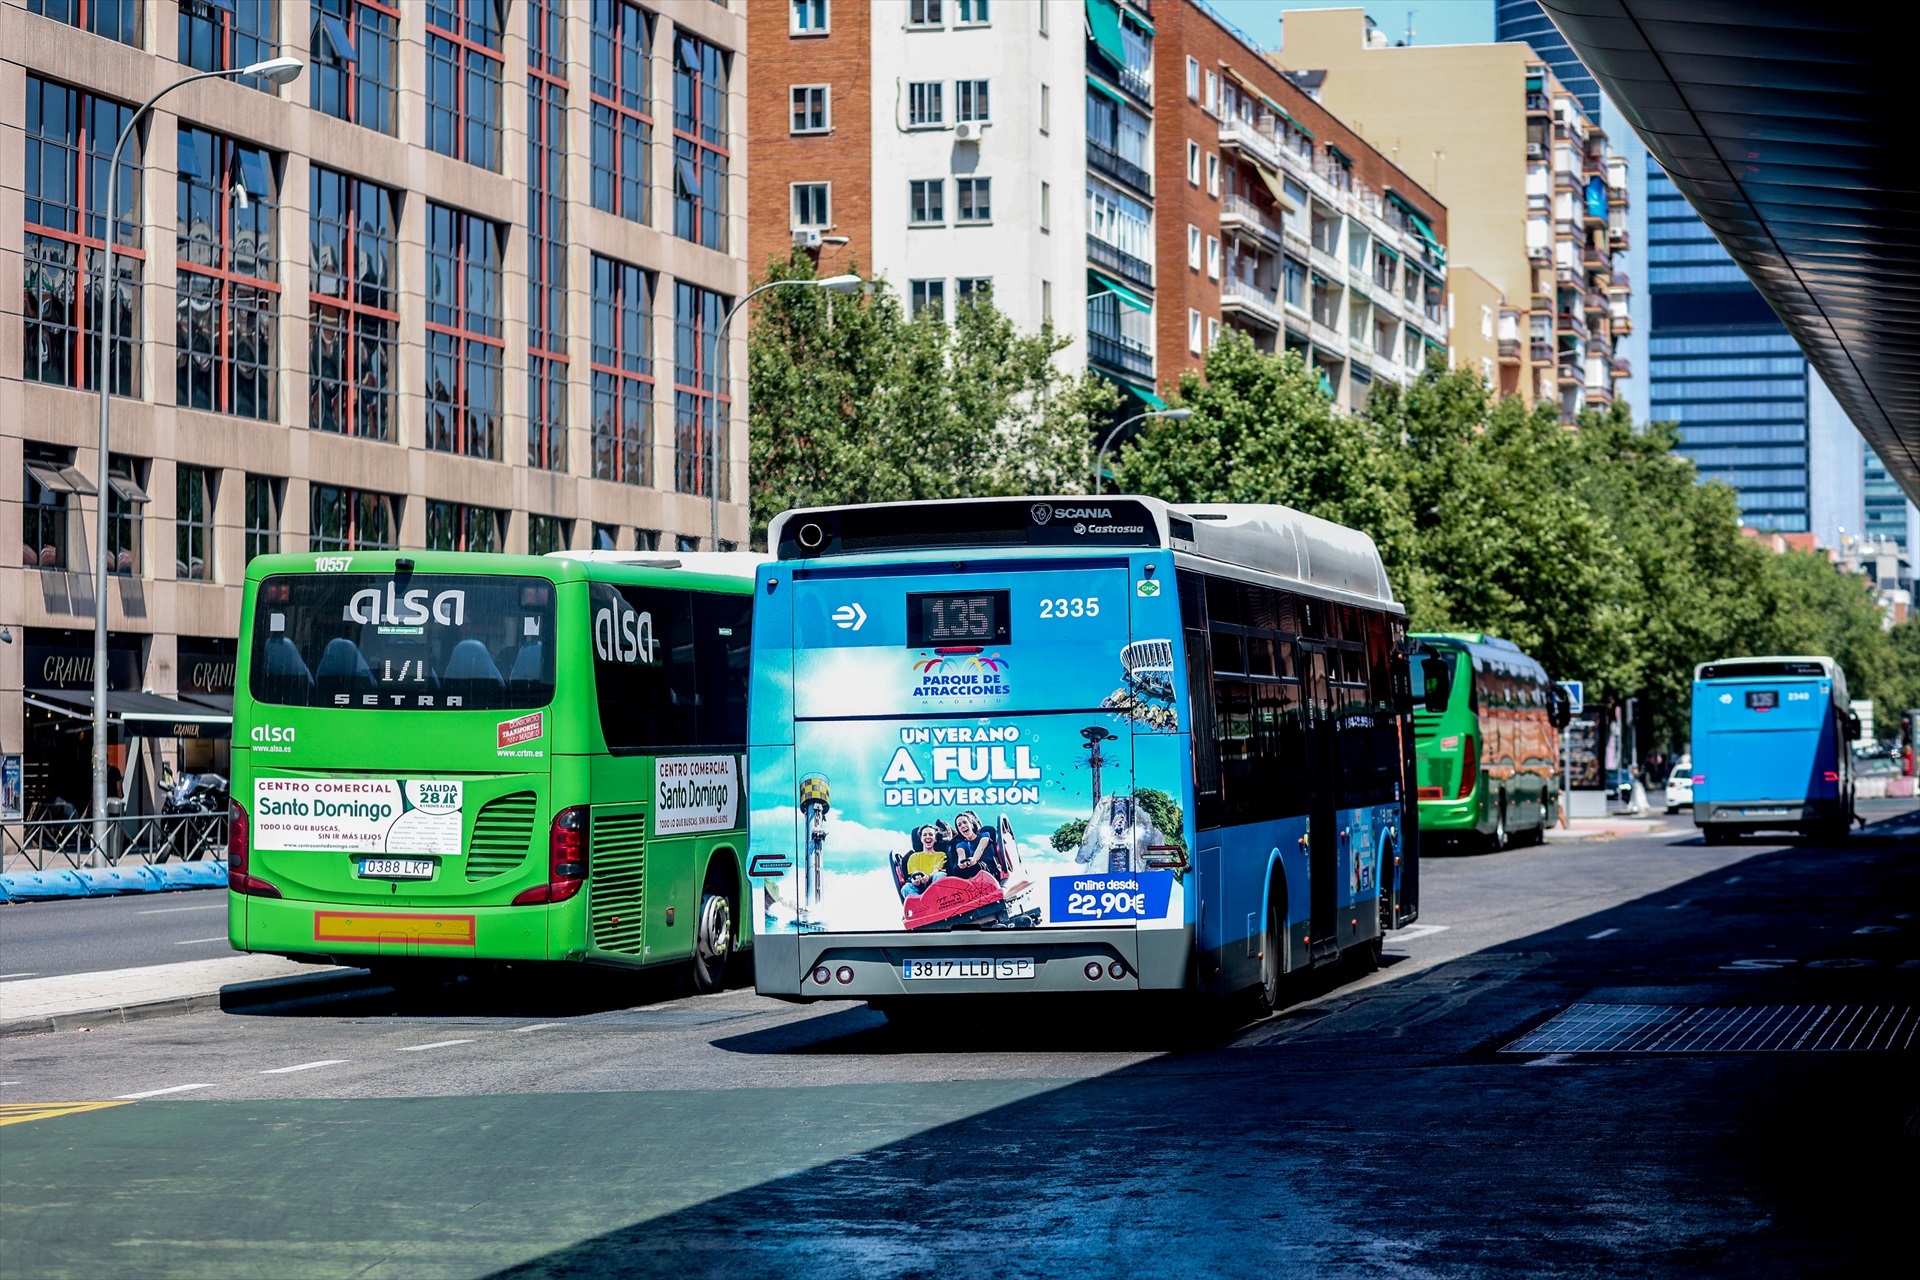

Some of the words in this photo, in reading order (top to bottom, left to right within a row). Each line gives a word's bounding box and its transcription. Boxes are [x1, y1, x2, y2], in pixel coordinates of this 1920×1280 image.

[1054, 508, 1112, 519] SCANIA
[1088, 524, 1144, 533] Castrosua
[314, 556, 353, 572] 10557
[349, 580, 465, 626] alsa
[1039, 597, 1100, 618] 2335
[932, 599, 988, 636] 135
[595, 596, 653, 663] alsa
[43, 655, 110, 689] GRANI
[193, 662, 235, 693] GRANI
[922, 675, 978, 686] PARQUE
[982, 674, 1001, 684] DE
[913, 684, 1011, 697] ATRACCIONES
[334, 693, 463, 707] SETRA
[173, 723, 200, 738] GRANIER
[251, 723, 295, 742] alsa
[901, 727, 930, 744] UN
[932, 726, 1020, 743] VERANO
[252, 745, 292, 753] www.alsa.es
[497, 749, 543, 758] www.crtm.es
[660, 762, 688, 778] CENTRO
[690, 761, 729, 776] COMERCIAL
[882, 747, 925, 783] A
[932, 745, 1041, 782] FULL
[258, 781, 310, 792] CENTRO
[315, 783, 391, 793] COMERCIAL
[419, 784, 458, 793] SALIDA
[885, 788, 915, 806] DE
[917, 780, 1039, 806] DIVERSIÓN
[420, 792, 441, 804] 28
[659, 780, 687, 811] Santo
[688, 779, 728, 813] Domingo
[259, 797, 309, 816] Santo
[313, 799, 392, 822] Domingo
[293, 824, 308, 832] QUE
[310, 825, 341, 833] BUSCAS,
[342, 832, 358, 840] MÁS
[360, 833, 382, 841] LEJOS
[368, 860, 400, 873] 0388
[404, 861, 430, 874] LKP
[1073, 879, 1106, 891] Online
[1107, 879, 1139, 891] desde
[1068, 892, 1146, 919] 22,90€
[913, 961, 954, 977] 3817
[959, 961, 990, 976] LLD
[1001, 960, 1029, 976] SP
